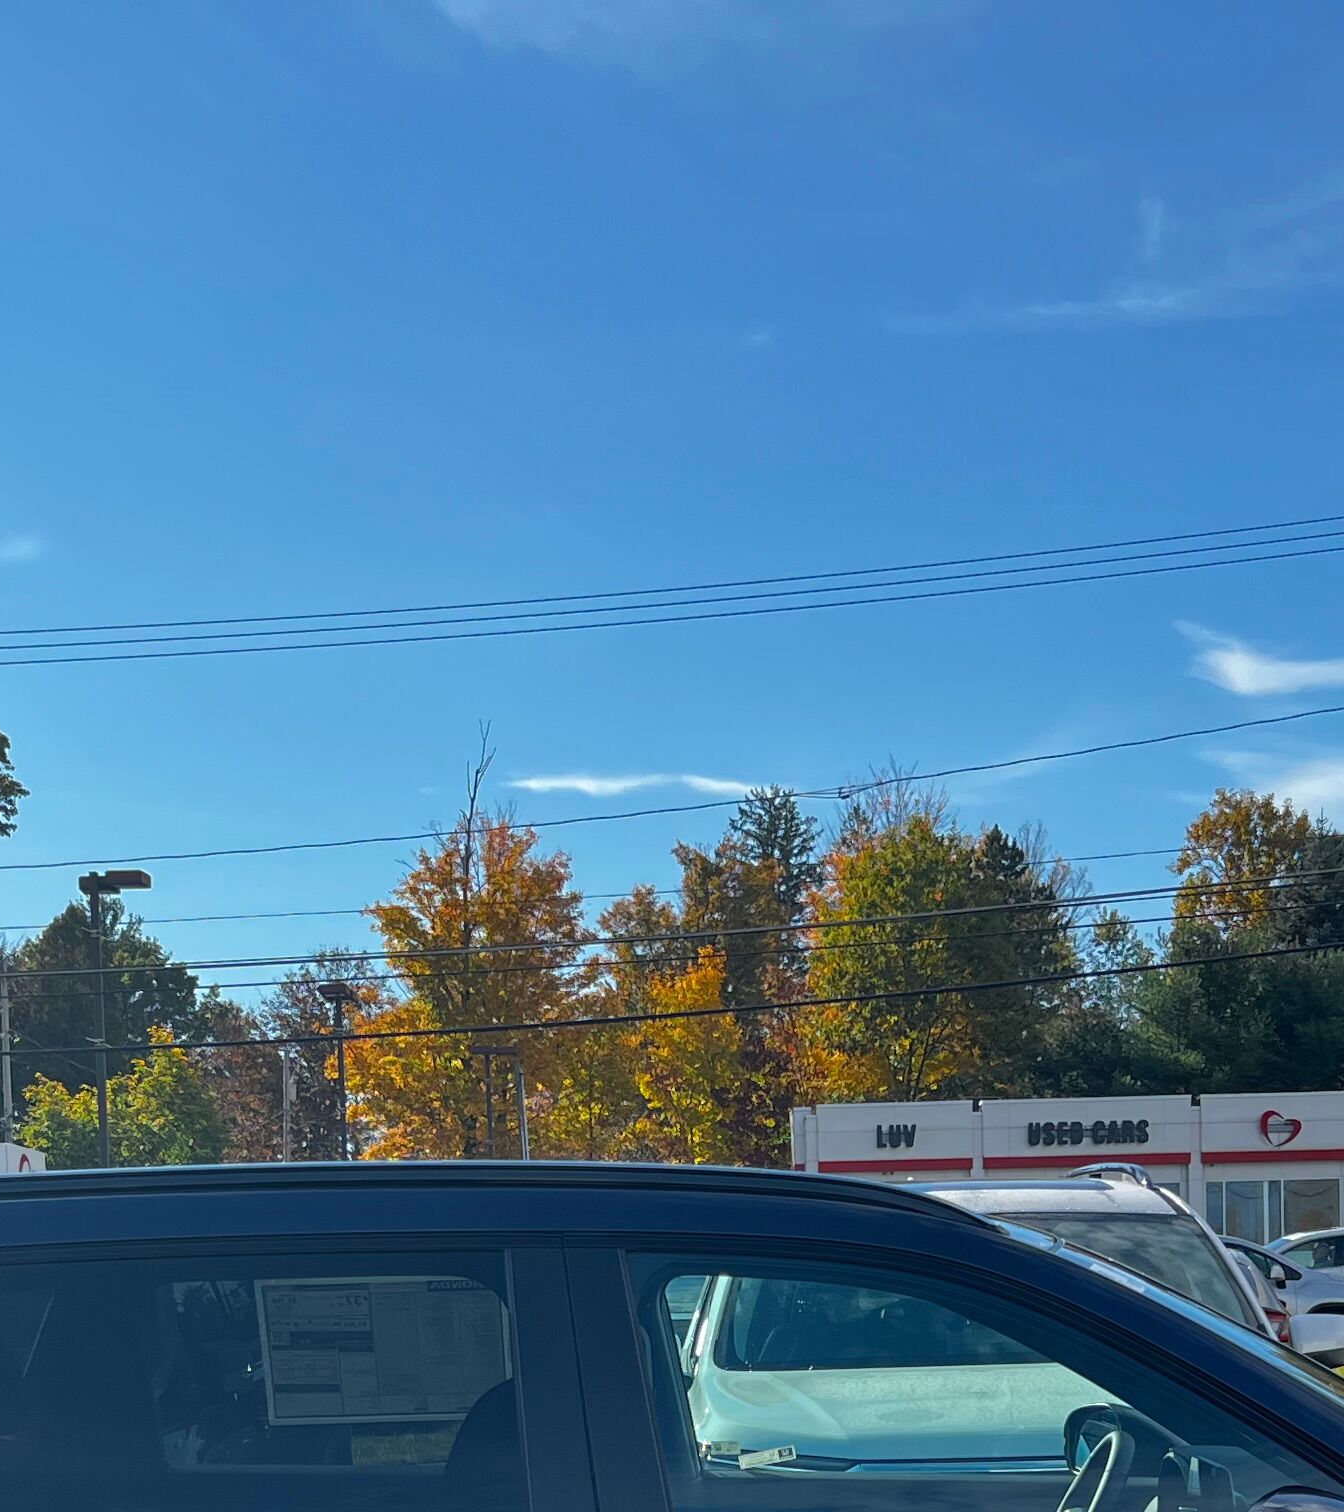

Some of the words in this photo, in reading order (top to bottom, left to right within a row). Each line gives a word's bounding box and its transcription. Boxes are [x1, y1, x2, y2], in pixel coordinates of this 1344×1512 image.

[876, 1124, 916, 1148] LUV
[1027, 1121, 1084, 1146] USED
[1092, 1119, 1149, 1144] CARS
